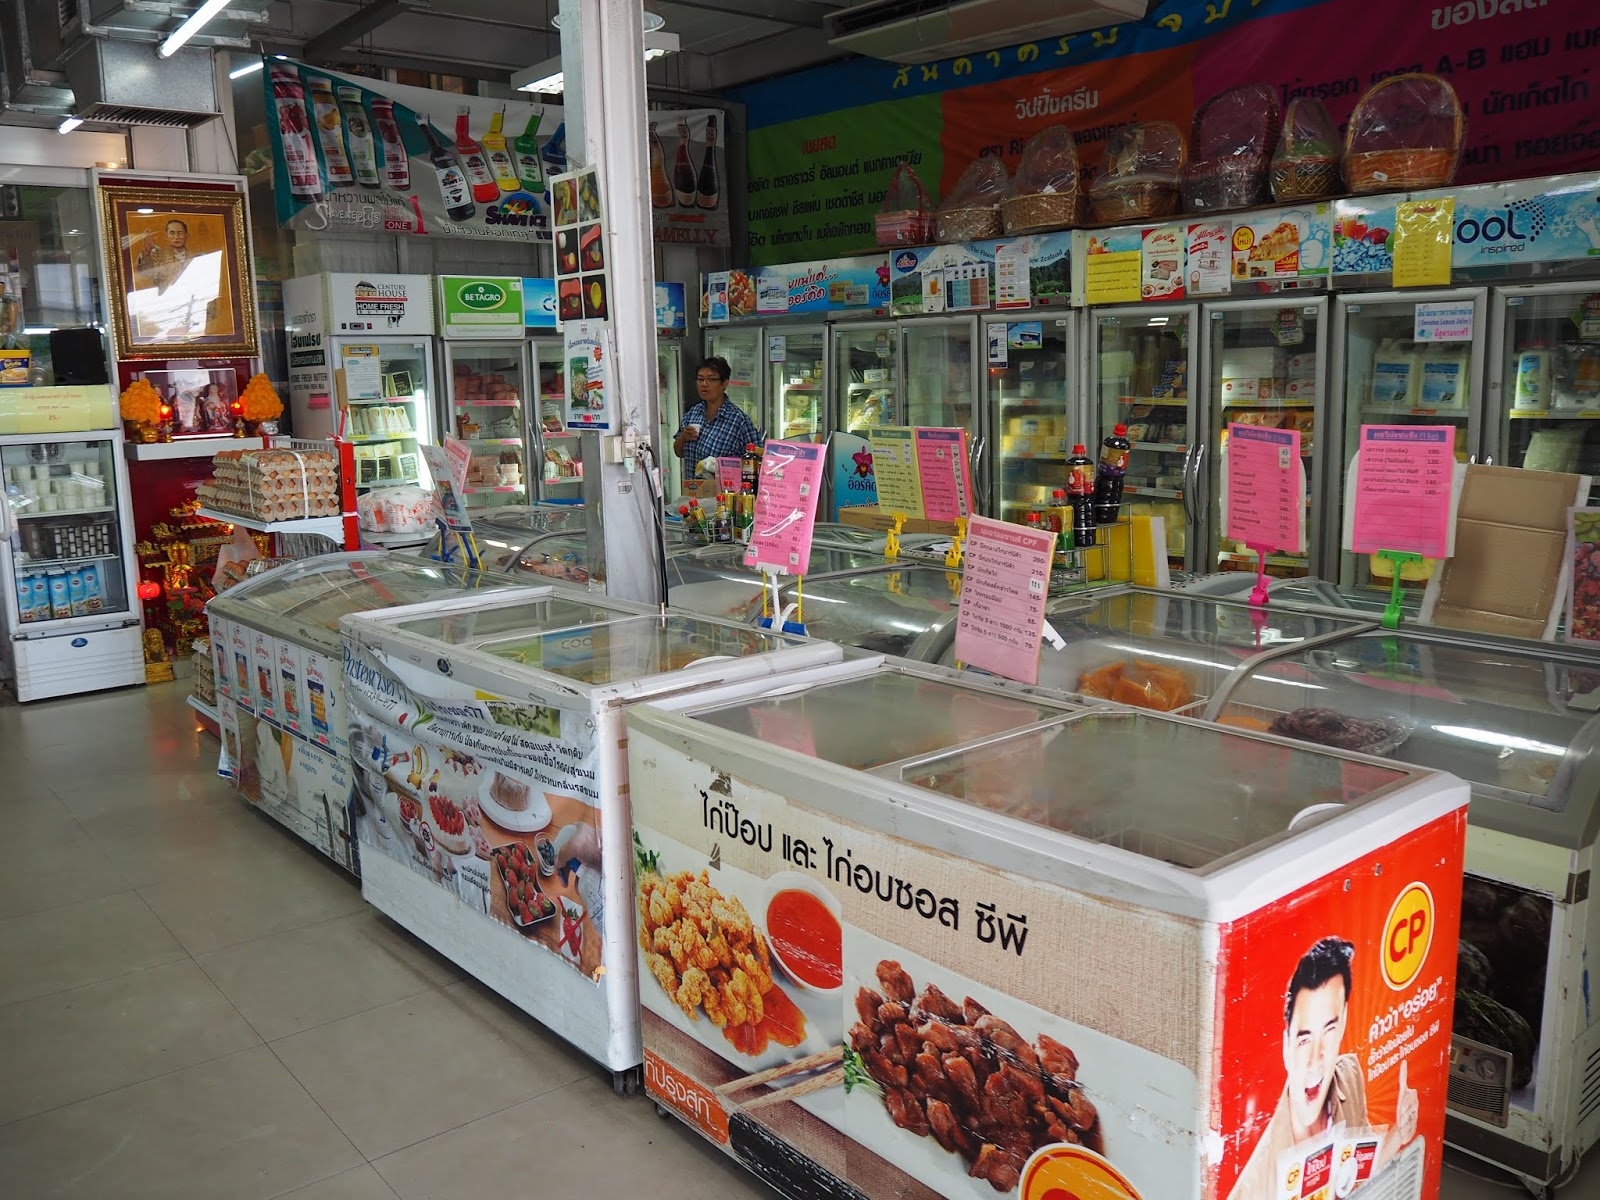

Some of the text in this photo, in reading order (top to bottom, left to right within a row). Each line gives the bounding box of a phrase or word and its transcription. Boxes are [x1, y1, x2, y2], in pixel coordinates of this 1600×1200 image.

[1434, 48, 1486, 76] A-B
[1014, 86, 1099, 121] วิปปิ้งครีม
[485, 205, 548, 227] SHAVE ICE
[387, 221, 408, 230] ONE
[1451, 209, 1527, 245] ool
[1039, 249, 1064, 263] Zealand
[1479, 243, 1525, 256] inspired
[378, 290, 407, 298] HOUSE
[464, 293, 501, 302] BETAGRO
[1022, 537, 1039, 548] CPF
[699, 789, 1030, 959] ไก่ป๊อป และ ไก่อบซอส ซีพี
[1389, 909, 1427, 963] CP
